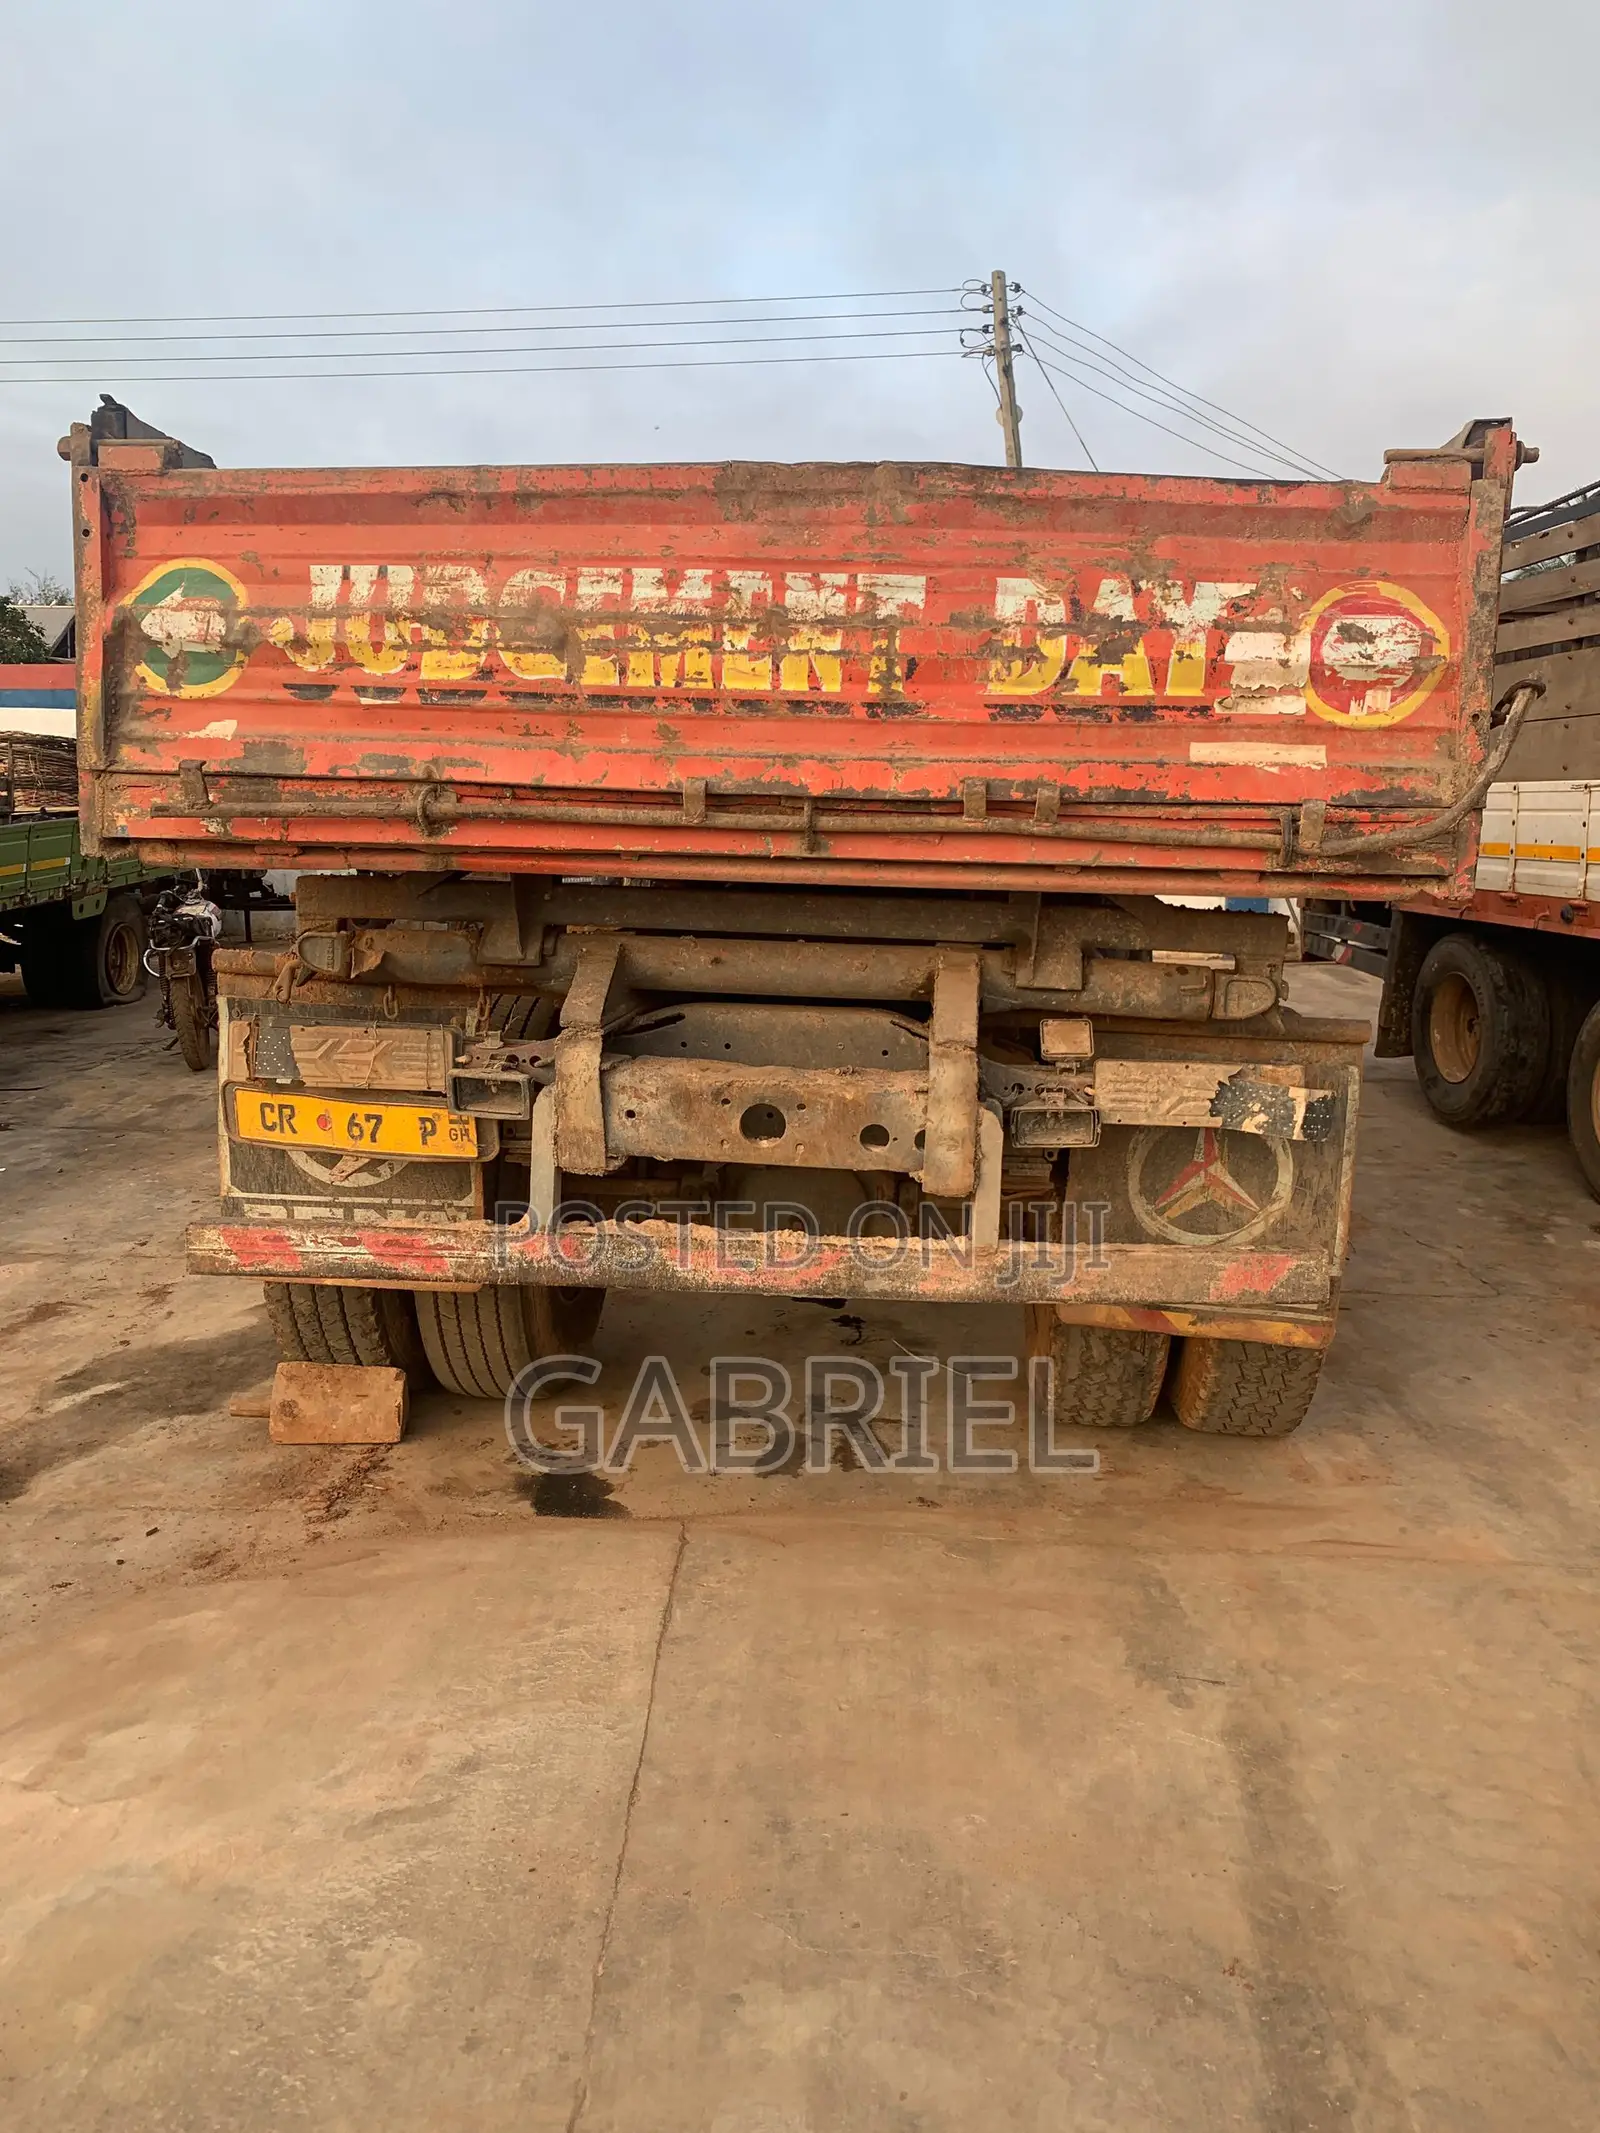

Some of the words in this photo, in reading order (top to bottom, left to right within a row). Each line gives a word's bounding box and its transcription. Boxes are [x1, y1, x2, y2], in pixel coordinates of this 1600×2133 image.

[979, 576, 1258, 697] DAY
[260, 1102, 298, 1134] CR
[347, 1112, 383, 1143] 67
[418, 1116, 437, 1146] P
[449, 1128, 470, 1143] GH
